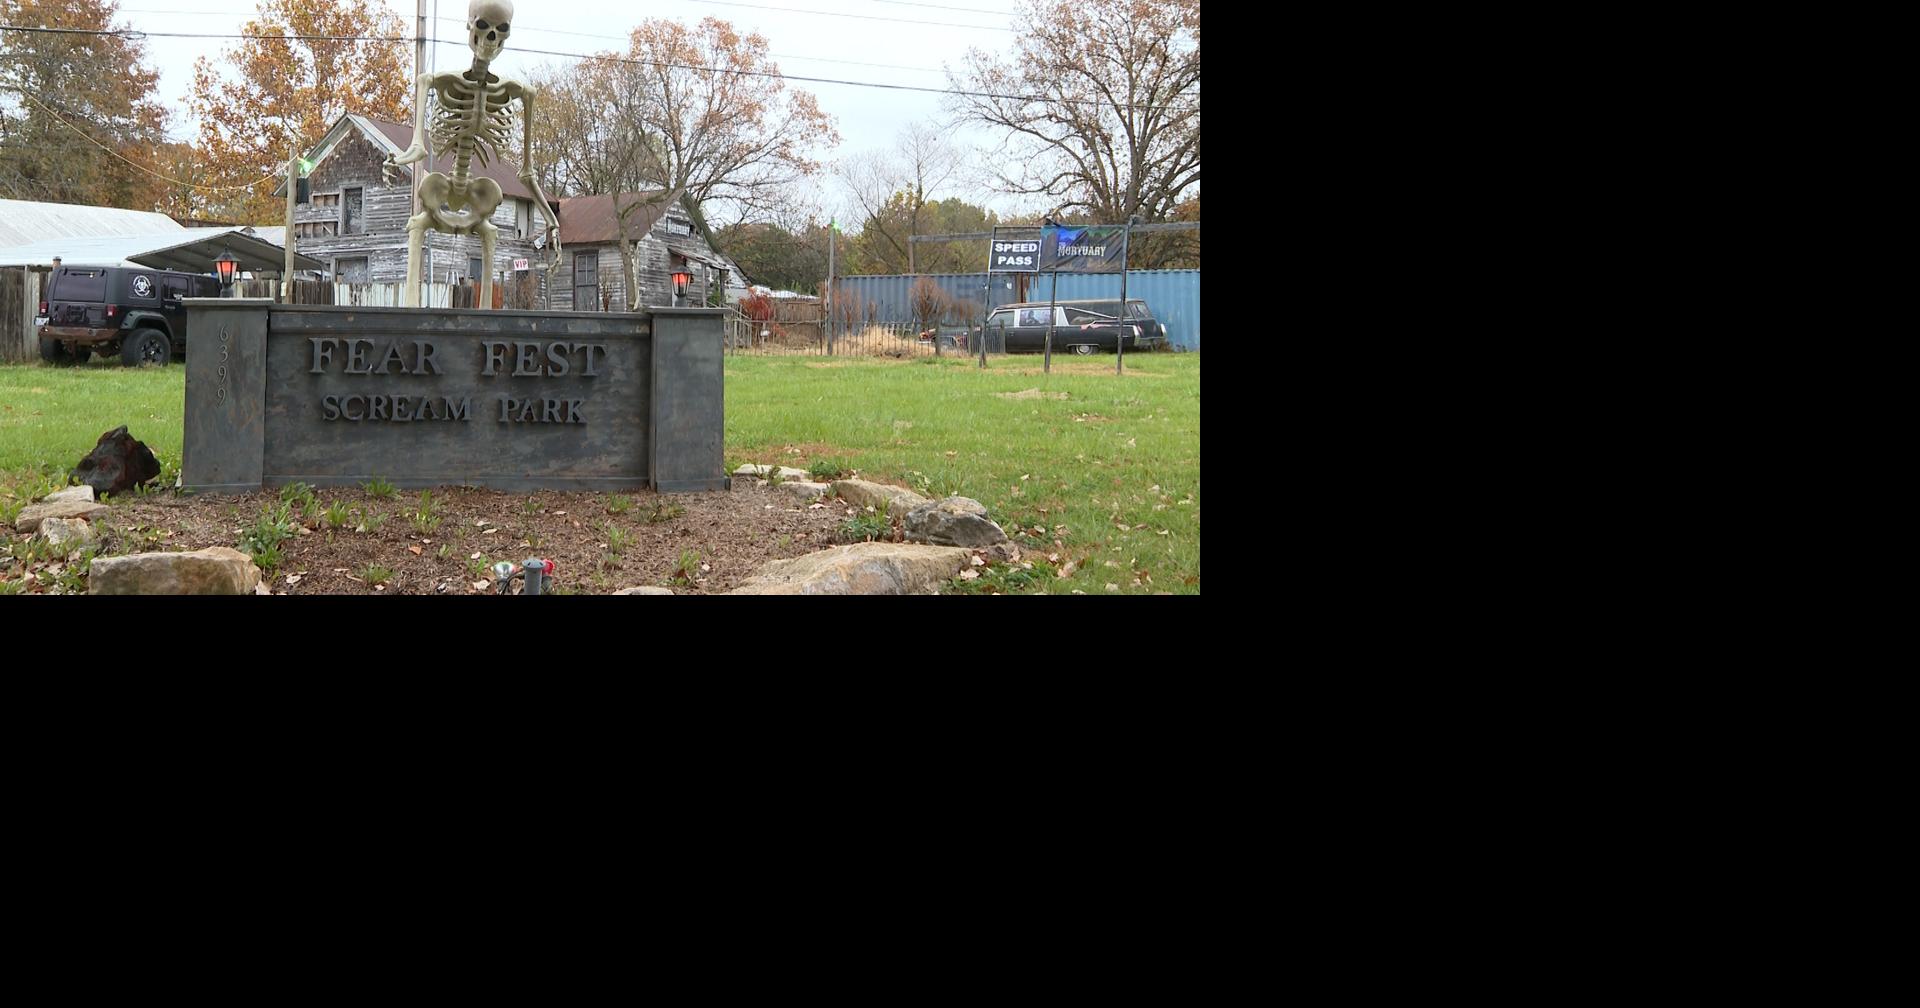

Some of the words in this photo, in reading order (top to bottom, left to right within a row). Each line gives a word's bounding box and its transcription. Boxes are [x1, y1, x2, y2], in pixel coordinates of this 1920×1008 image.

[994, 242, 1038, 253] SPEED
[514, 260, 528, 269] VIP
[997, 255, 1033, 266] PASS
[217, 324, 229, 406] 6399
[308, 336, 444, 376] FEAR
[481, 340, 608, 377] FEST
[321, 394, 473, 422] SCREAM
[499, 398, 587, 424] PARK
